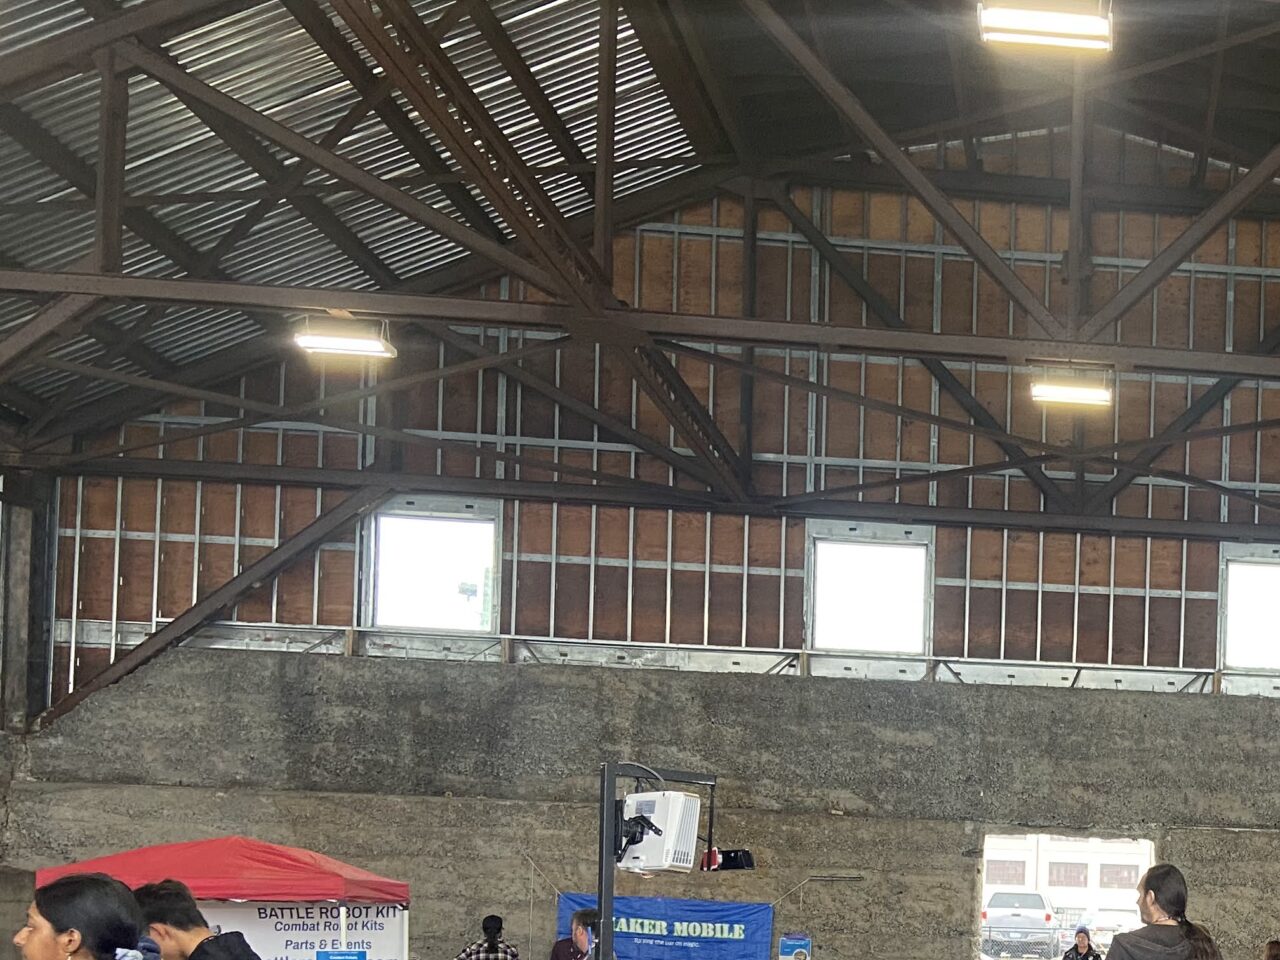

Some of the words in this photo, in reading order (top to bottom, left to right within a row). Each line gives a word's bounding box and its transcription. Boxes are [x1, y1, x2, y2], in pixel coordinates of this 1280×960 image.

[257, 907, 314, 919] BATTLE
[274, 921, 320, 931] Combat
[323, 921, 358, 931] Root
[361, 920, 385, 931] Kits
[673, 921, 745, 940] MOBILE
[285, 939, 315, 950] Parts
[319, 939, 327, 950] &
